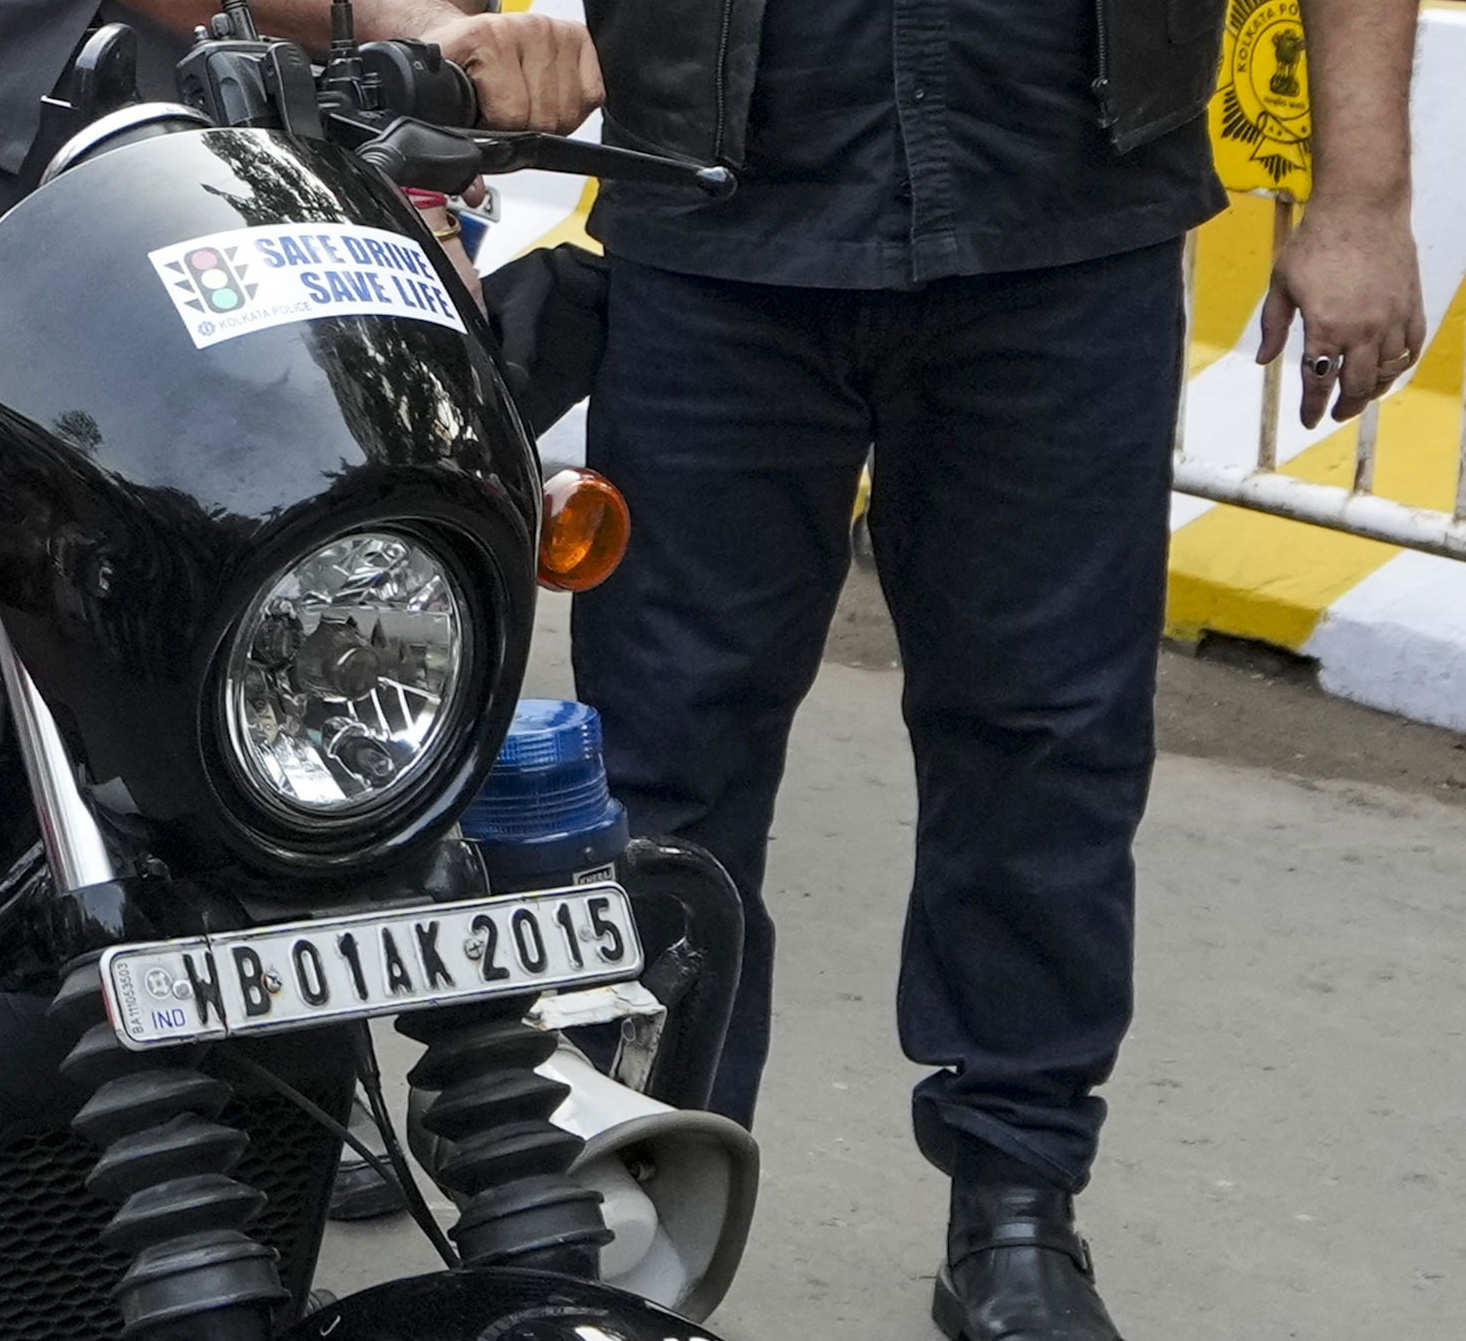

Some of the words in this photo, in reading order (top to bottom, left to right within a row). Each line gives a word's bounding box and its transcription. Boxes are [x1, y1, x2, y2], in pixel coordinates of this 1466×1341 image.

[1237, 7, 1277, 73] KOLKATA
[253, 235, 341, 269] SAFE
[343, 237, 434, 280] DRIVE
[218, 308, 271, 331] KOLKATA
[272, 300, 314, 318] POLICE
[301, 271, 391, 305] SAVE
[397, 276, 454, 320] LIFE
[470, 896, 627, 982] 2015
[151, 1007, 186, 1031] IND
